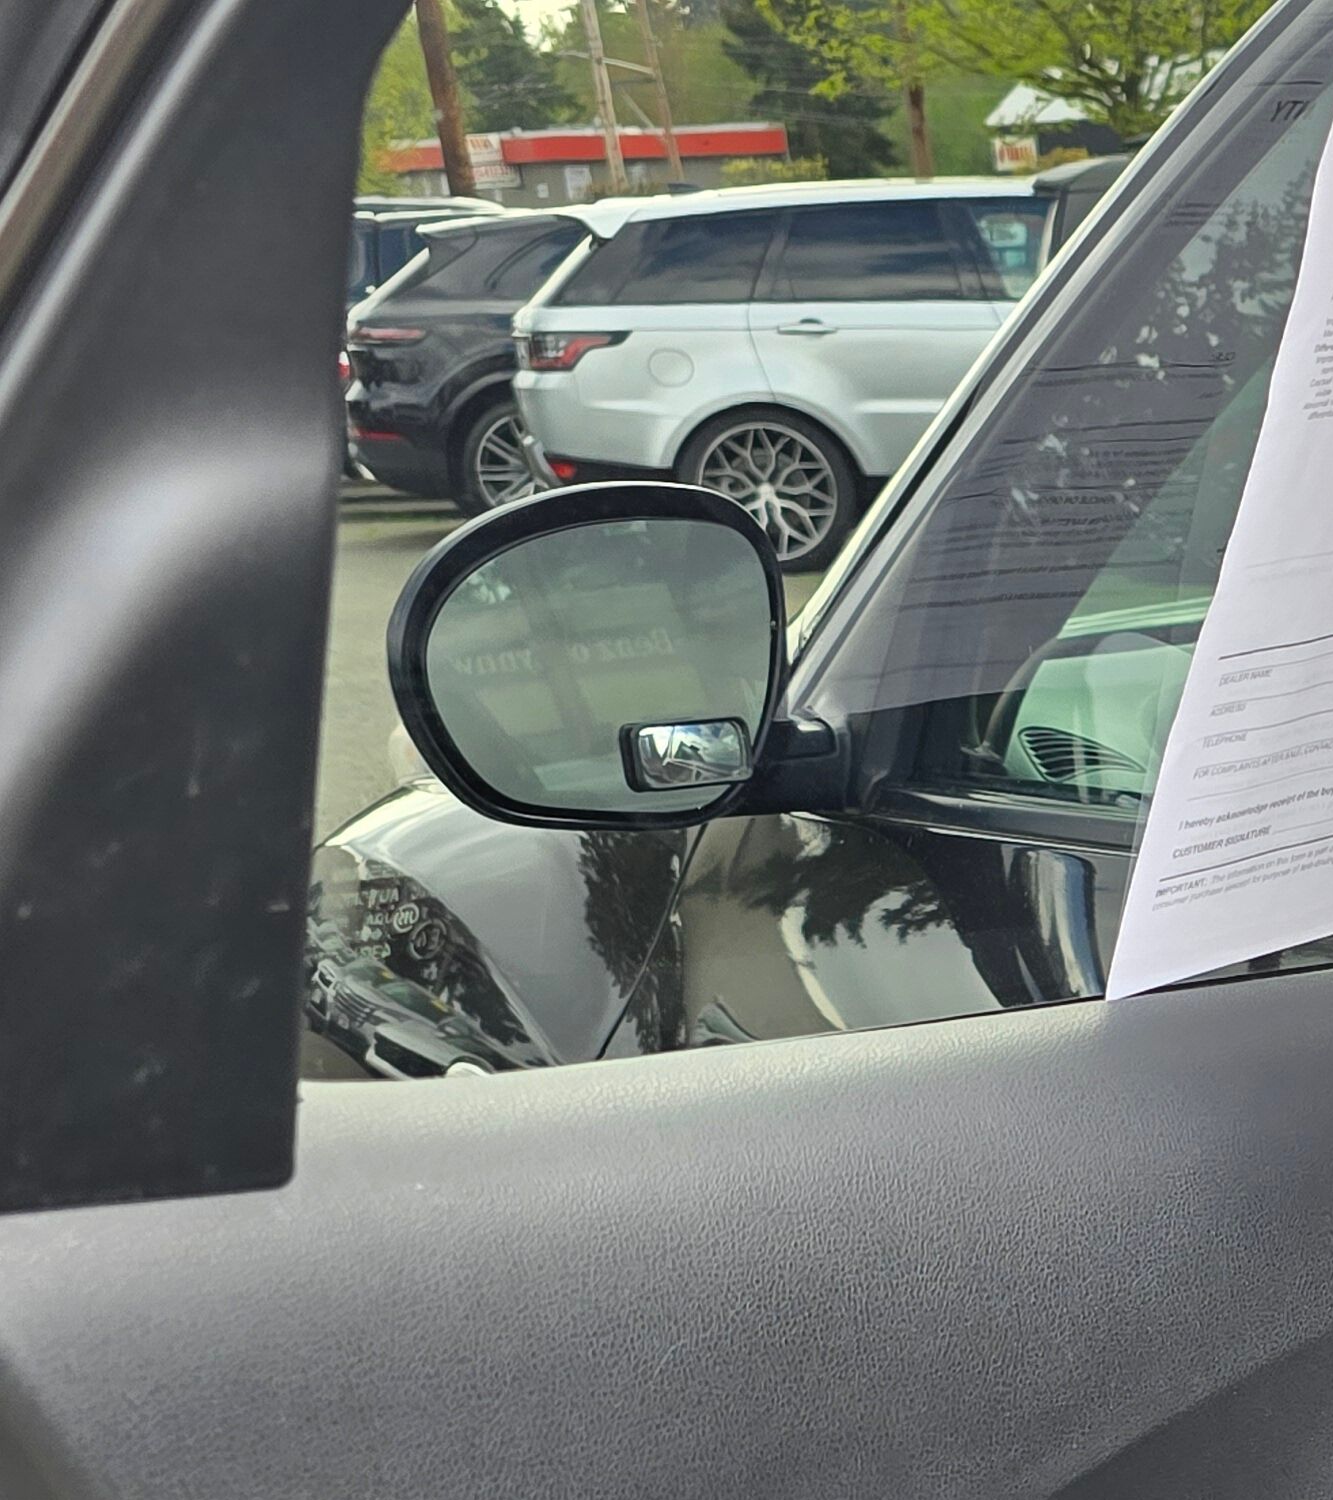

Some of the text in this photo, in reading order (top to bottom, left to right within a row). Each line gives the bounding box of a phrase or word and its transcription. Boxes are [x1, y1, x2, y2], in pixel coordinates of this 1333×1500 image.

[1218, 669, 1273, 687] DEALER NAME
[1184, 817, 1215, 830] hereby
[1216, 803, 1269, 823] acknowledge
[1269, 794, 1297, 809] receipt
[1306, 789, 1320, 799] the
[1172, 825, 1272, 859] CUSTOMER SIGNATURE
